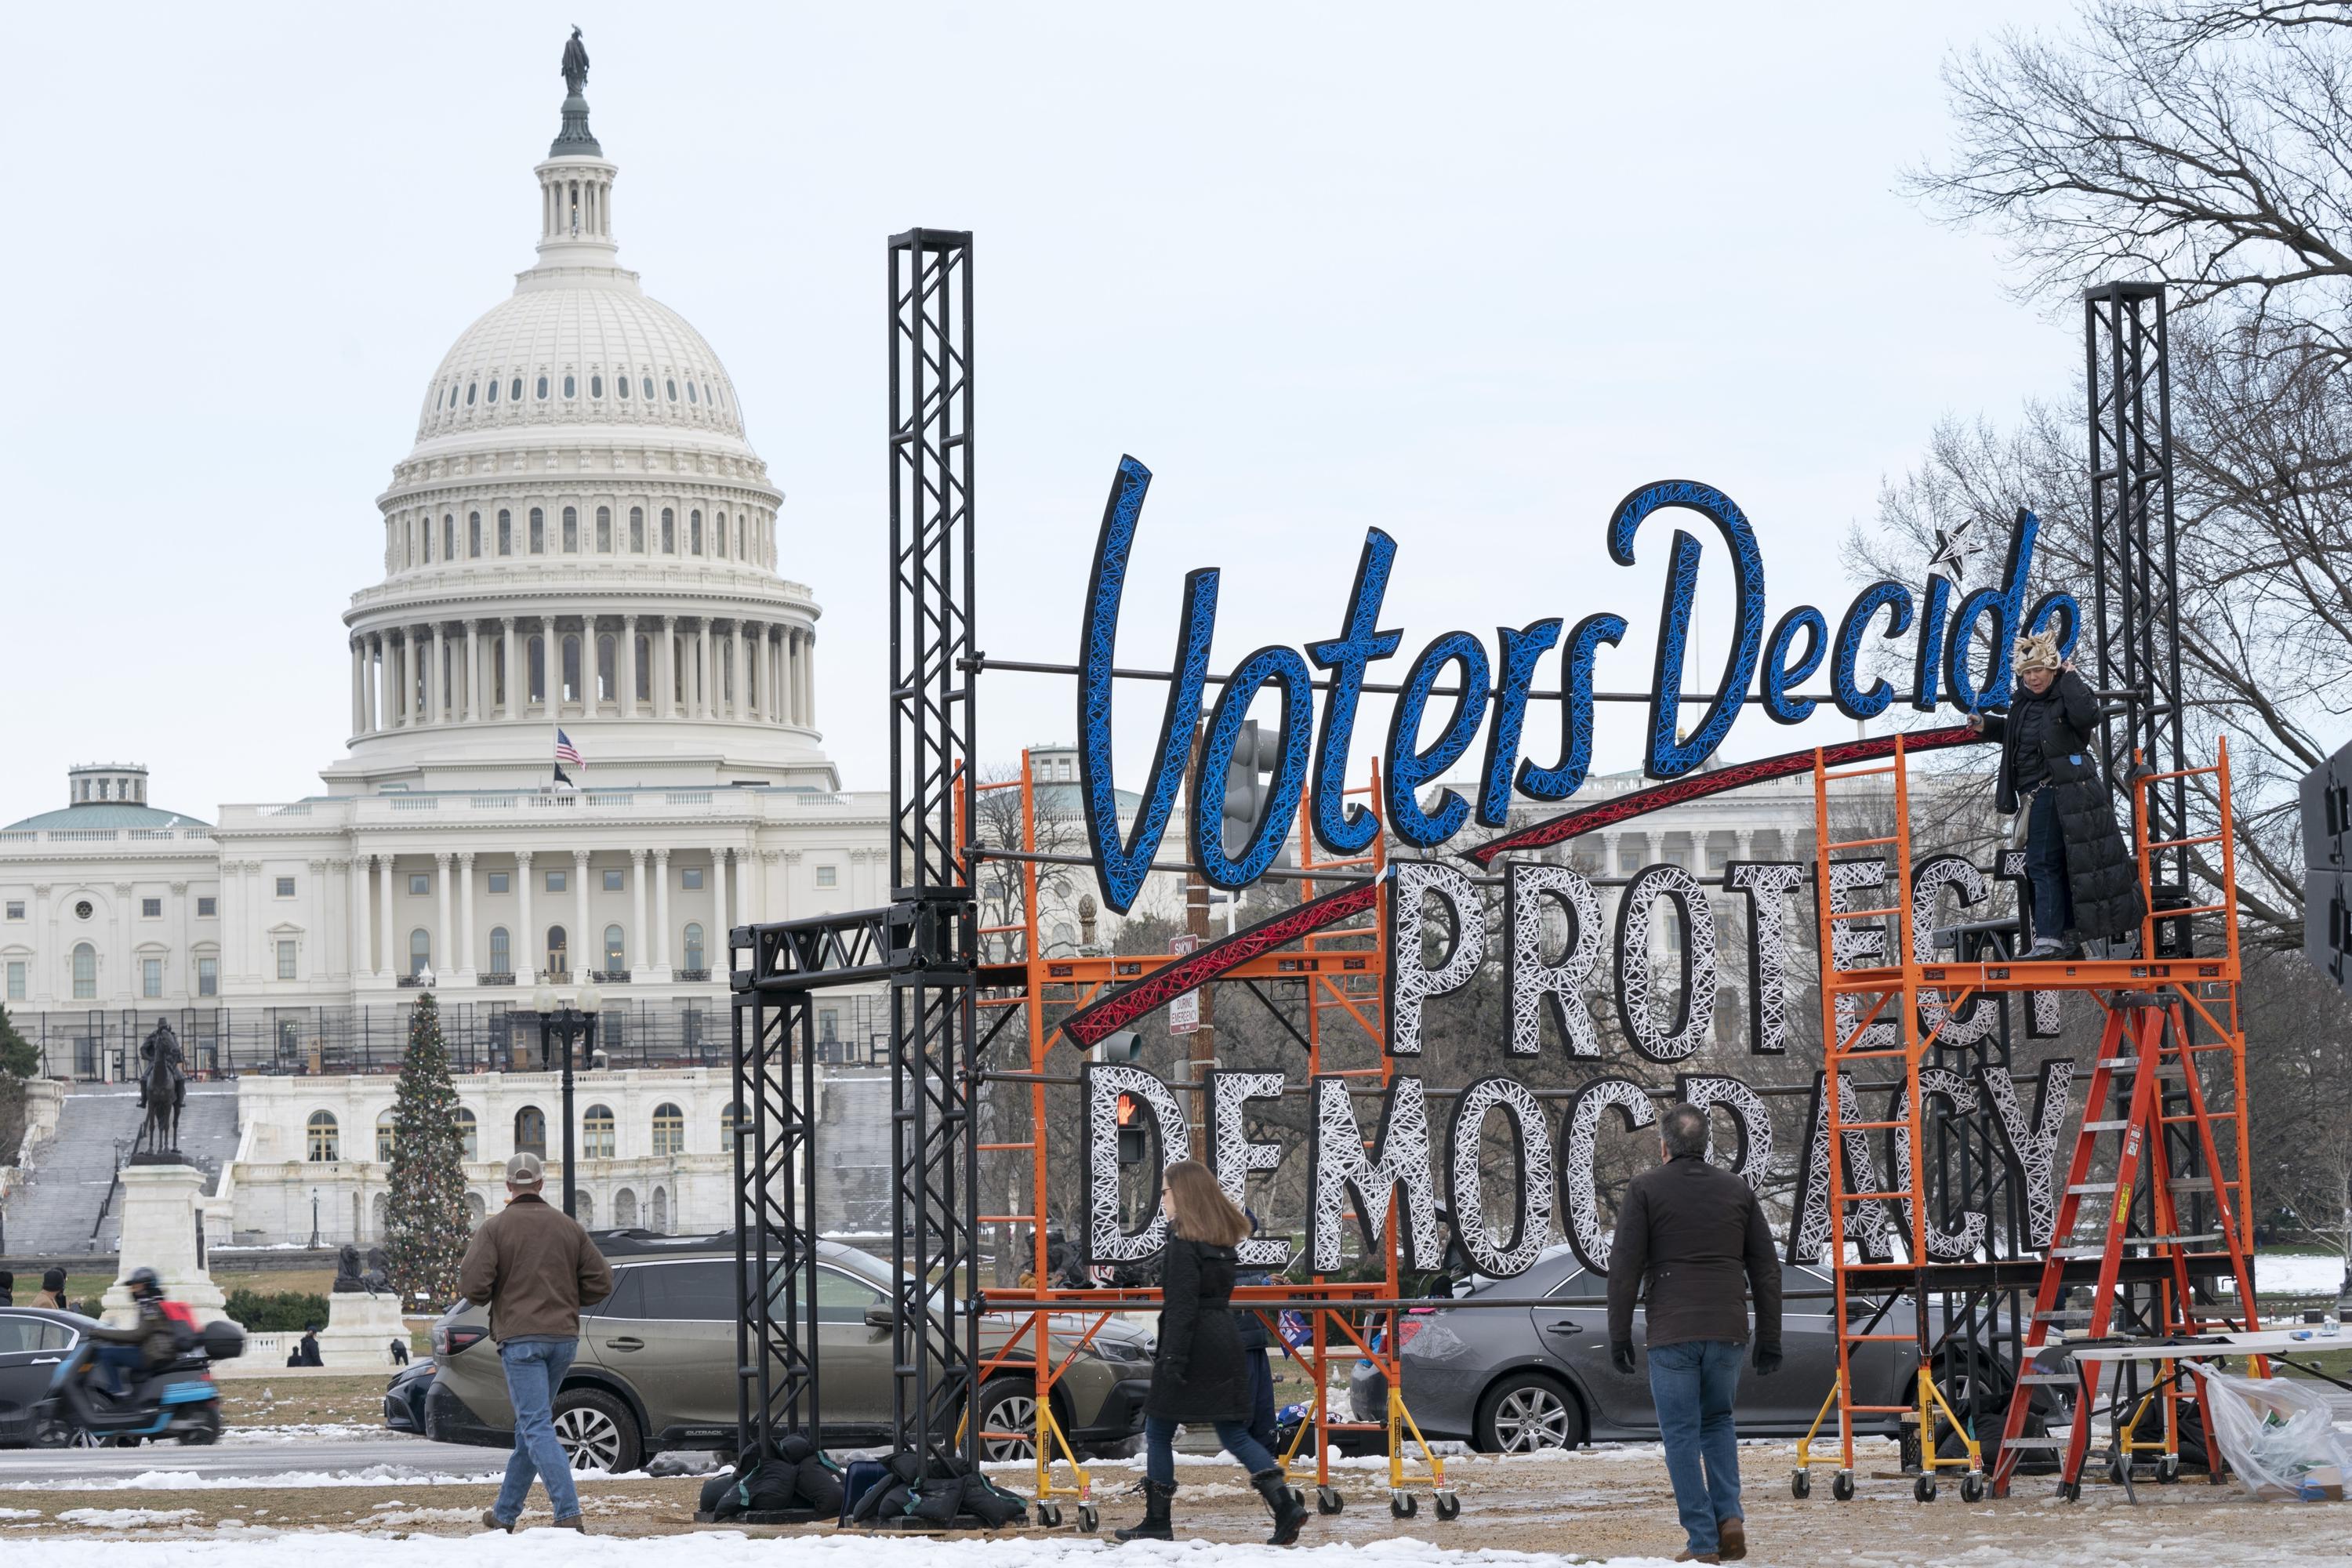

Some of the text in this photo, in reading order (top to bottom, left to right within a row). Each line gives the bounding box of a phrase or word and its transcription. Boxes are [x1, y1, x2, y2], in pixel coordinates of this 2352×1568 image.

[1077, 454, 1628, 916] Voters
[1174, 940, 1192, 955] SNOW
[1177, 996, 1192, 1010] DURING
[1172, 1009, 1197, 1023] EMERGENCY
